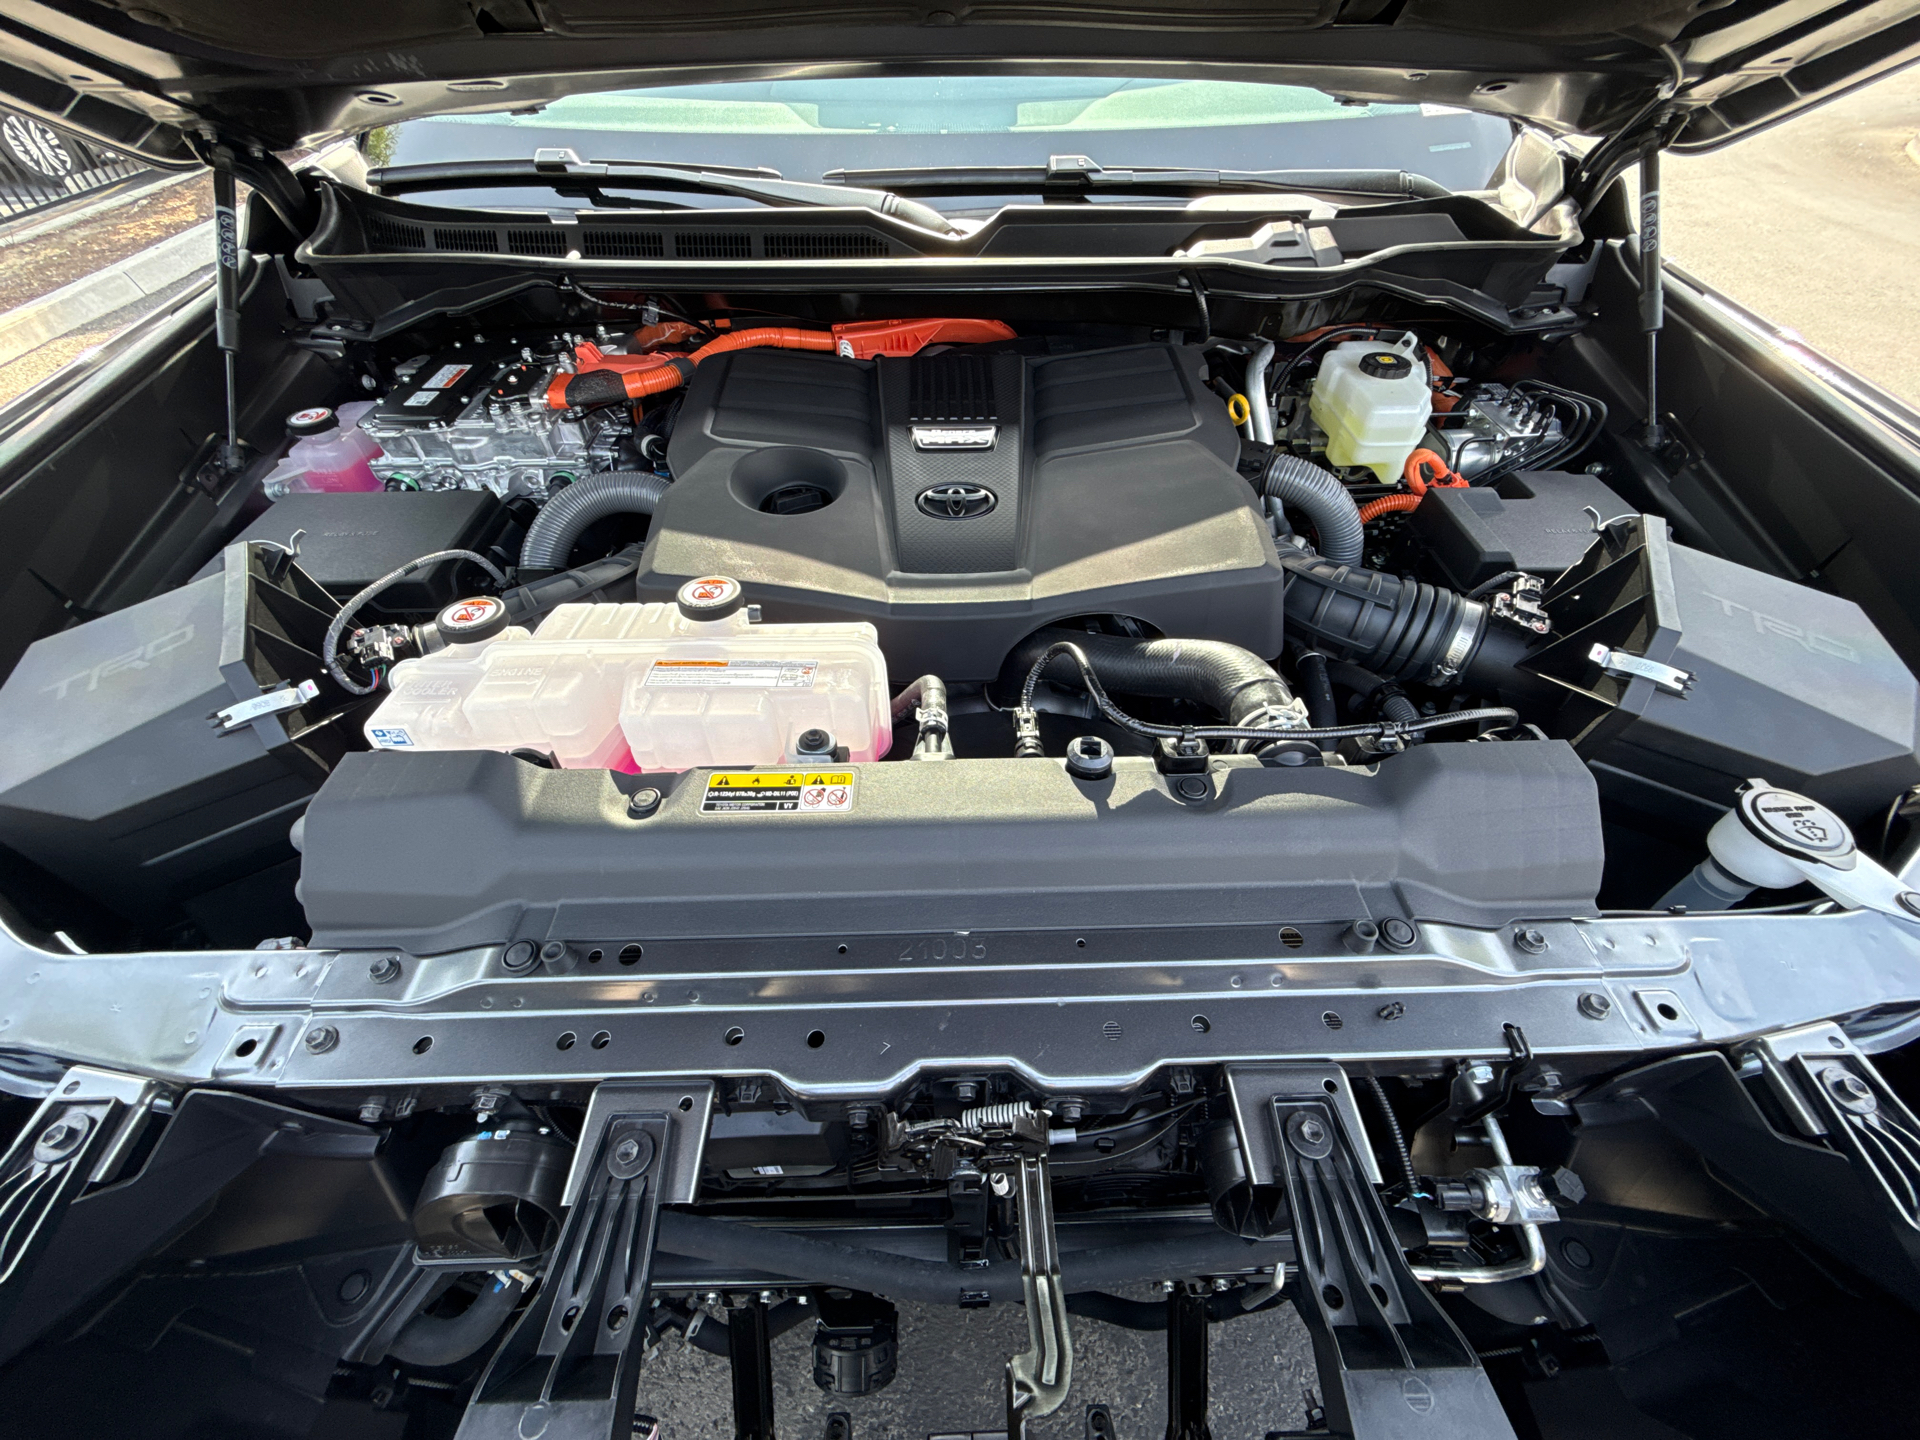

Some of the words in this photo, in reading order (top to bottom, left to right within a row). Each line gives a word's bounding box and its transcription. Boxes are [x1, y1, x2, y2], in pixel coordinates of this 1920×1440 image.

[1702, 590, 1861, 665] TRD
[38, 623, 195, 700] TRD
[489, 667, 545, 676] ENGINE
[403, 687, 458, 696] COOLER
